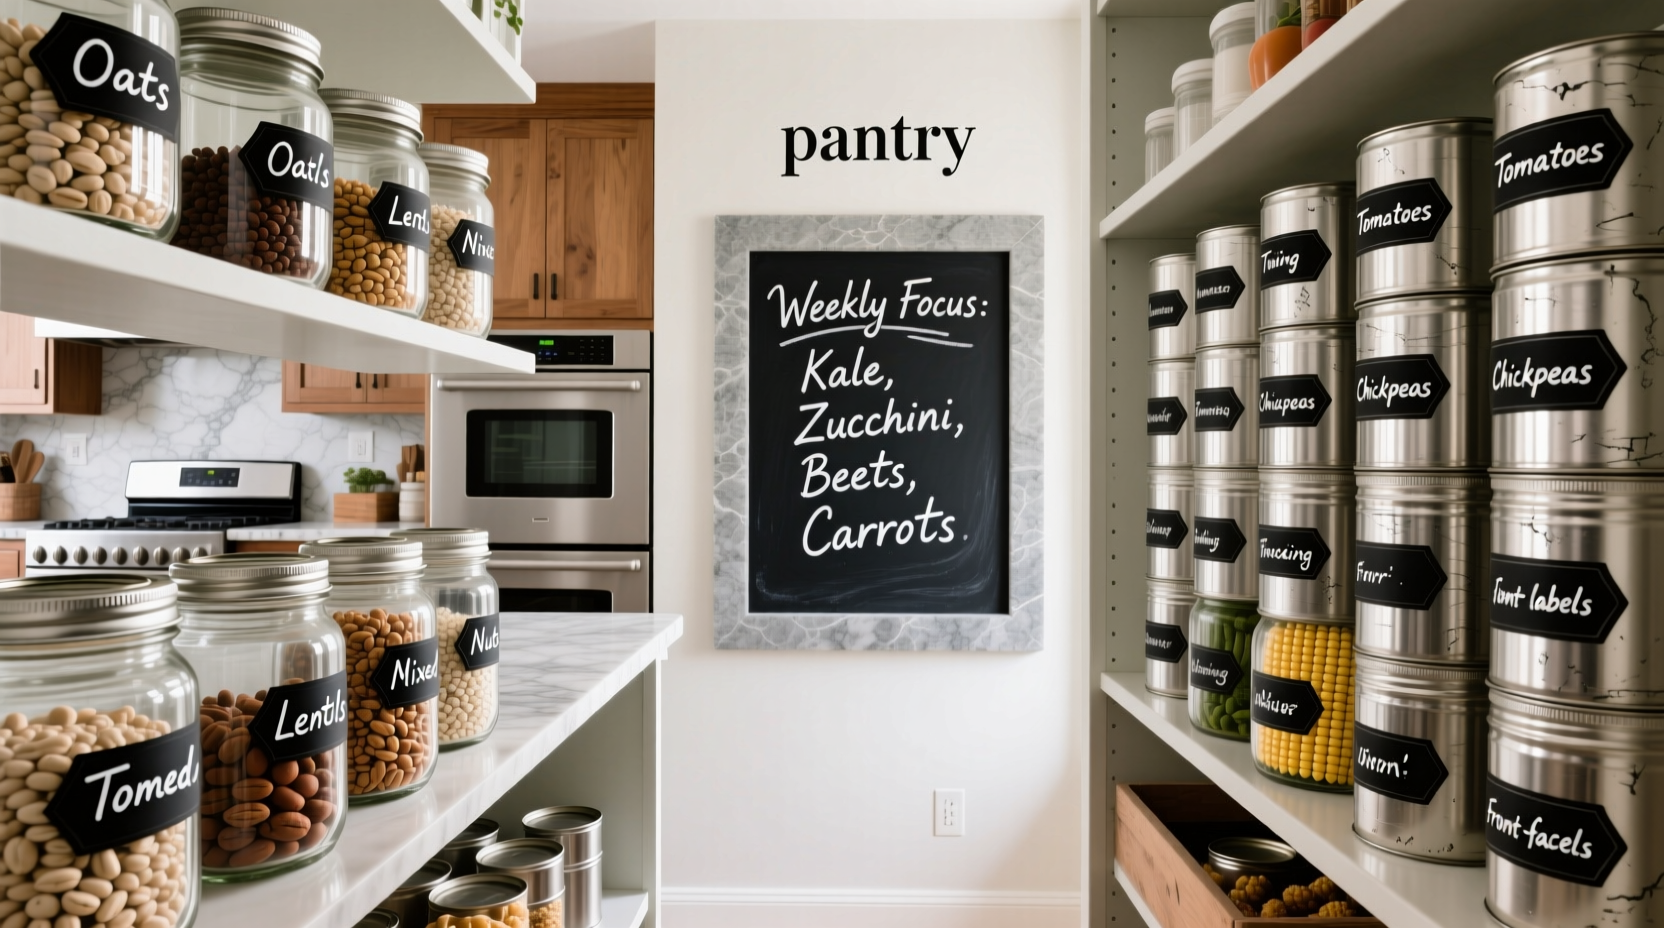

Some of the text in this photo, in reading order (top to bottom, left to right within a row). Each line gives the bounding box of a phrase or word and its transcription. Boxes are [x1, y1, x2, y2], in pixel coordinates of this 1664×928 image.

[73, 38, 169, 111] Oats
[781, 116, 976, 177] pantry
[1494, 142, 1604, 188] Tomatoes
[1357, 202, 1432, 235] Tomatoes
[767, 277, 988, 338] Weekly Focus:
[801, 346, 894, 394] Kale,
[1356, 375, 1432, 407] Chickpeas
[1492, 357, 1593, 398] Chickpeas
[794, 398, 964, 446] Zucchini,
[801, 450, 916, 498] Beets,
[802, 496, 968, 556] Carrots.
[1529, 583, 1593, 616] labels
